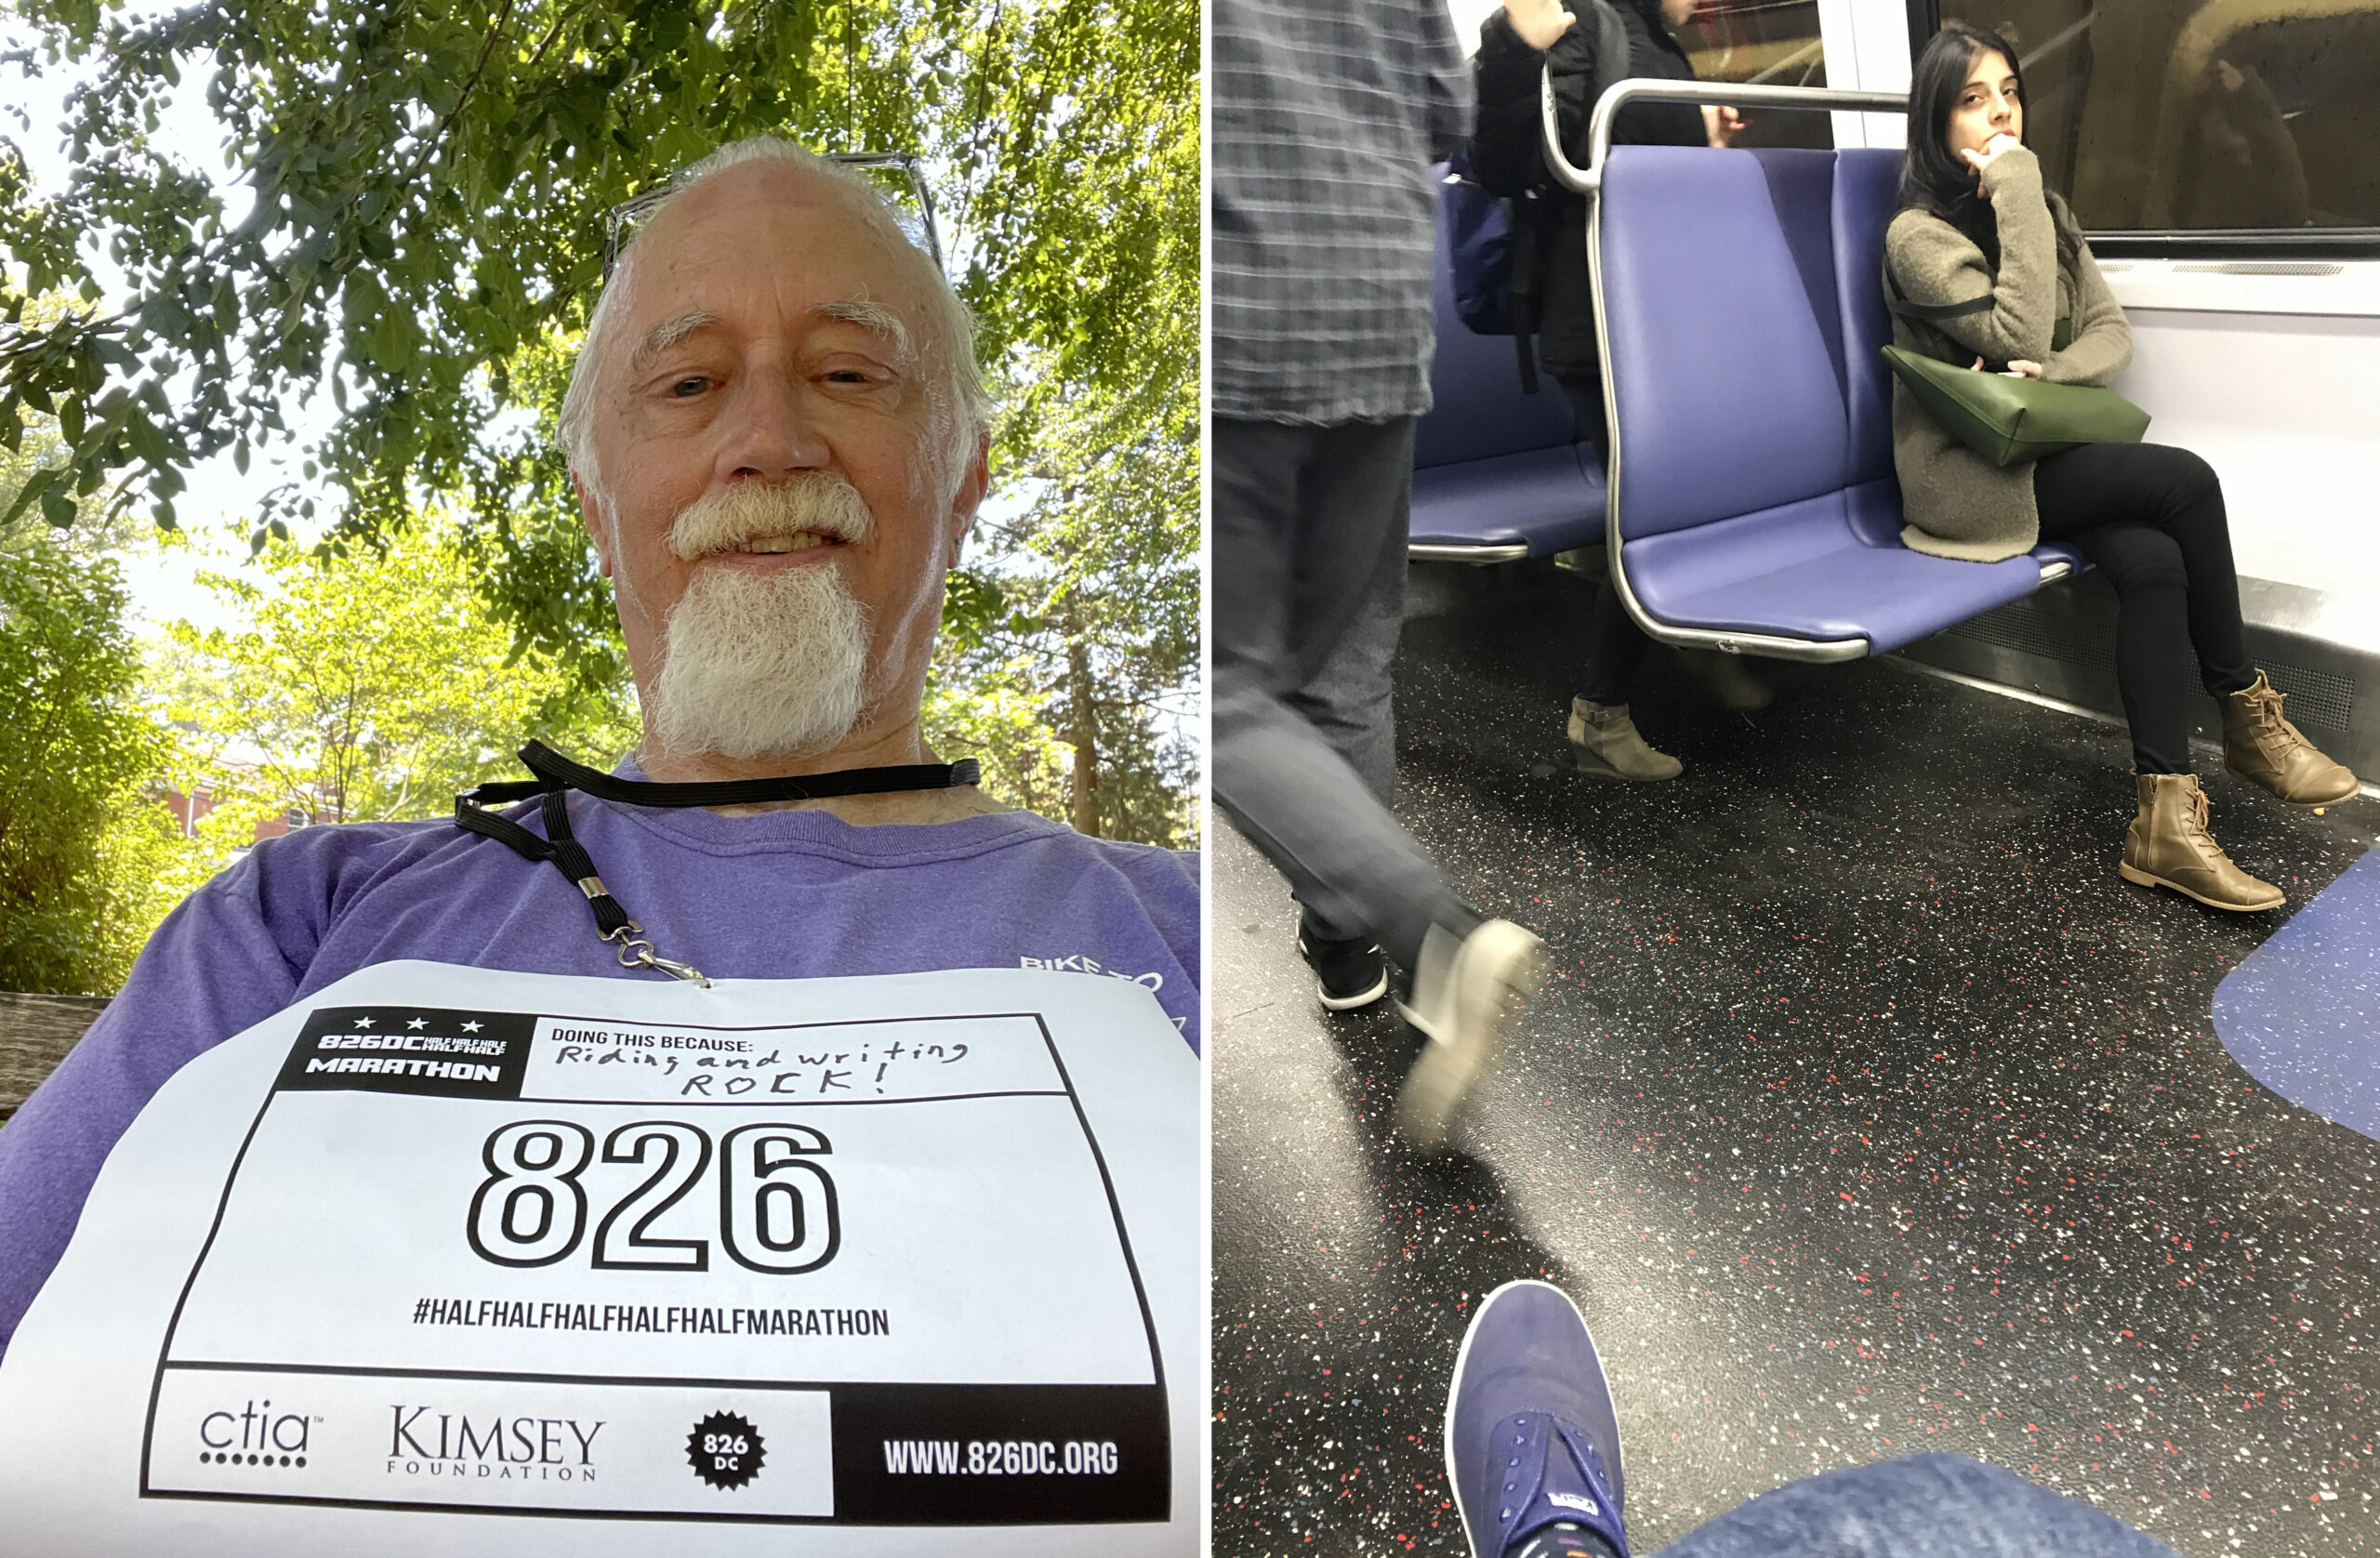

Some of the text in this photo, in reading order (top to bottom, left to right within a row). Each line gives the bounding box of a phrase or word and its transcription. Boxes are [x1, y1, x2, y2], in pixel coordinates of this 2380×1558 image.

[1020, 955, 1101, 974] BIKE
[318, 1035, 508, 1050] 826DC HALF HALF HALF
[551, 1028, 754, 1052] DOING THIS BECAUSE:
[305, 1058, 501, 1082] MARATHON
[555, 1041, 969, 1075] Riding and writing
[681, 1063, 888, 1096] ROCK!
[466, 1119, 841, 1274] 826
[413, 1298, 890, 1336] #HALFHALFHALFHALFHALFMARATHON
[704, 1434, 748, 1455] 826
[715, 1457, 739, 1472] DC
[884, 1440, 1118, 1475] WWW.826DC.ORG
[387, 1460, 597, 1482] FOUNDATION
